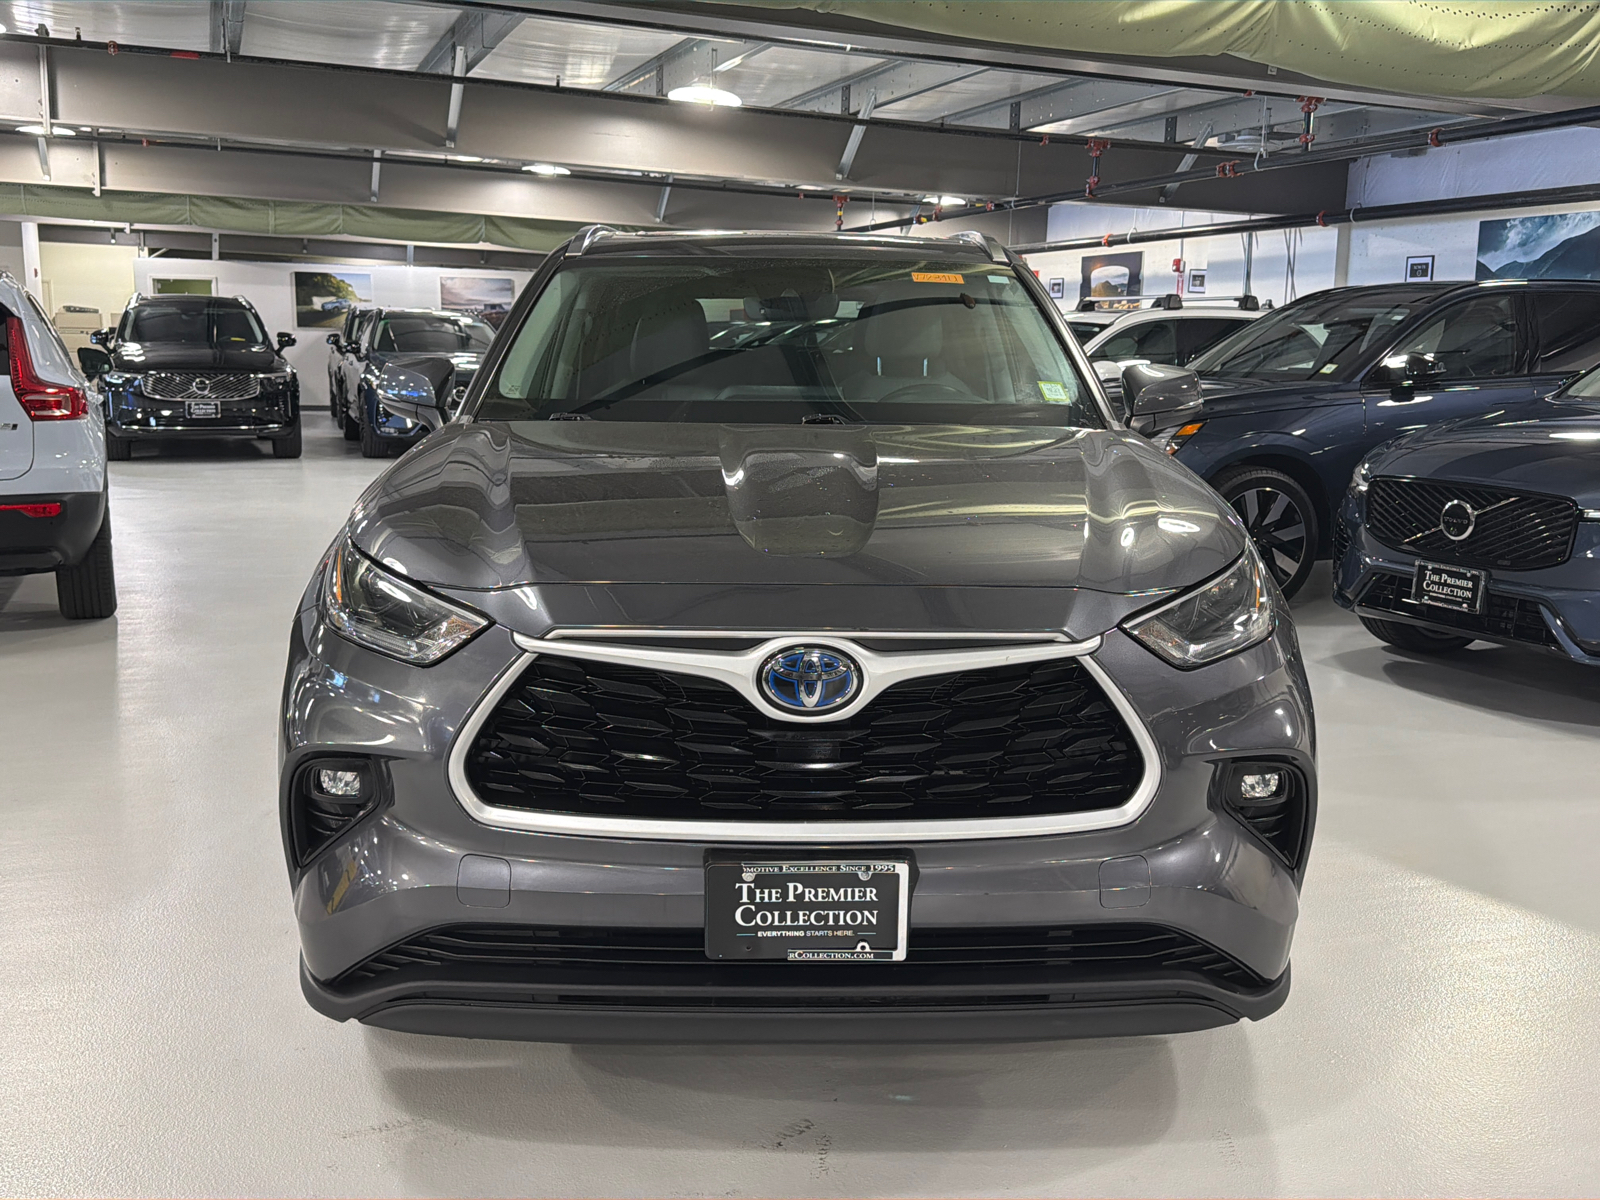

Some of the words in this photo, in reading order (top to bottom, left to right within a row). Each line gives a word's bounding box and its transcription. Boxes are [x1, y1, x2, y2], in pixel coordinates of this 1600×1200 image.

[1425, 570, 1441, 582] THE
[1441, 573, 1473, 588] PREMIER
[1423, 580, 1472, 598] COLLECTION
[782, 864, 838, 873] EXCELLENCE
[840, 864, 867, 872] SINCE
[870, 864, 895, 872] 1995
[735, 883, 782, 903] THE
[786, 882, 879, 902] PREMIER
[735, 904, 879, 926] COLLECTION
